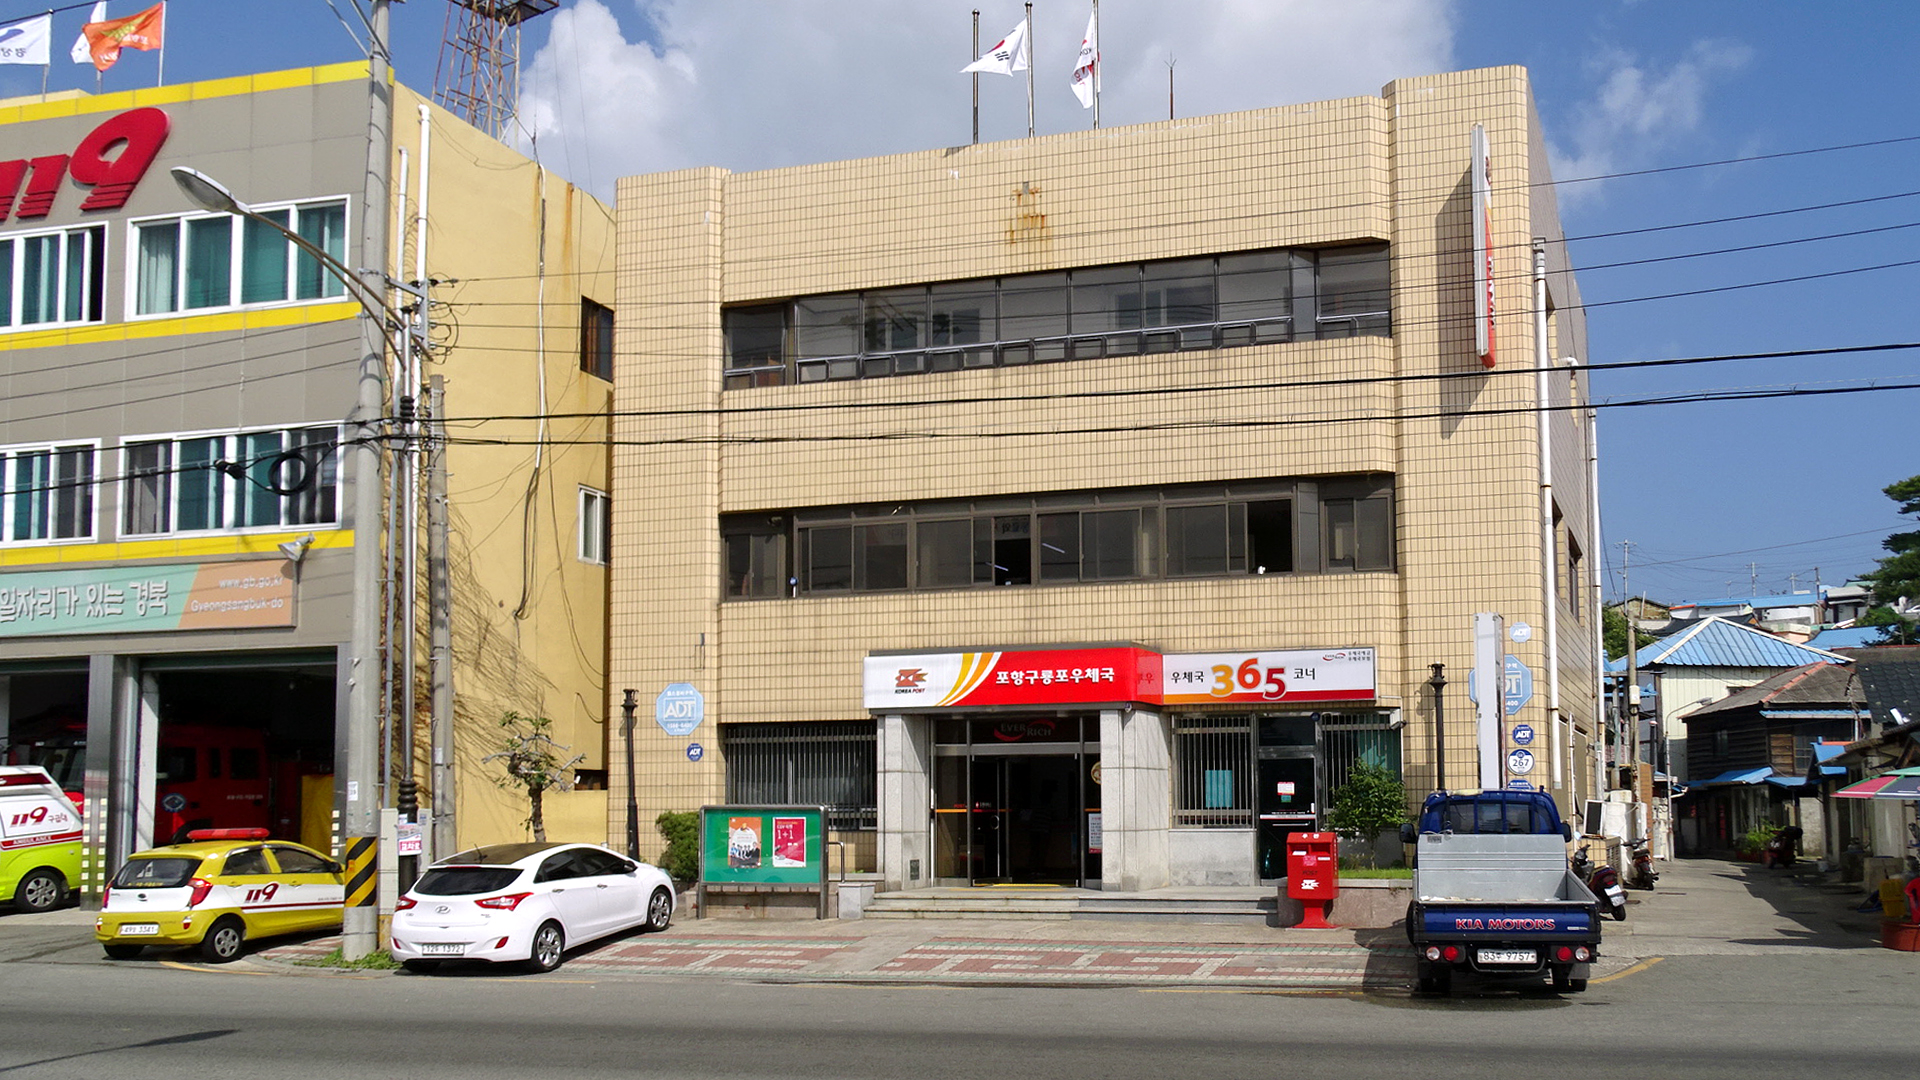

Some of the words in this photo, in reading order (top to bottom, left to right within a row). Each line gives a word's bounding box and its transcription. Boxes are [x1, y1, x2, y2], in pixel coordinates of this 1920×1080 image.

[218, 575, 284, 589] www.gb.go.kr
[0, 586, 79, 622] 일자리가
[86, 582, 125, 618] 있는
[128, 579, 169, 617] 경북
[190, 597, 284, 613] Gyeongsangbuk-do
[996, 667, 1115, 686] 포항구룡포우체국
[1171, 670, 1205, 684] 우체국
[1210, 657, 1287, 699] 365
[1293, 667, 1316, 681] 코너
[664, 701, 695, 718] ADT
[1001, 723, 1027, 733] EVER
[1026, 728, 1052, 737] RICH
[1512, 758, 1530, 767] 267
[9, 806, 48, 828] 119
[244, 882, 280, 903] 119
[1455, 918, 1485, 930] KIA
[1487, 918, 1556, 931] MOTORS
[1506, 951, 1531, 961] 9757
